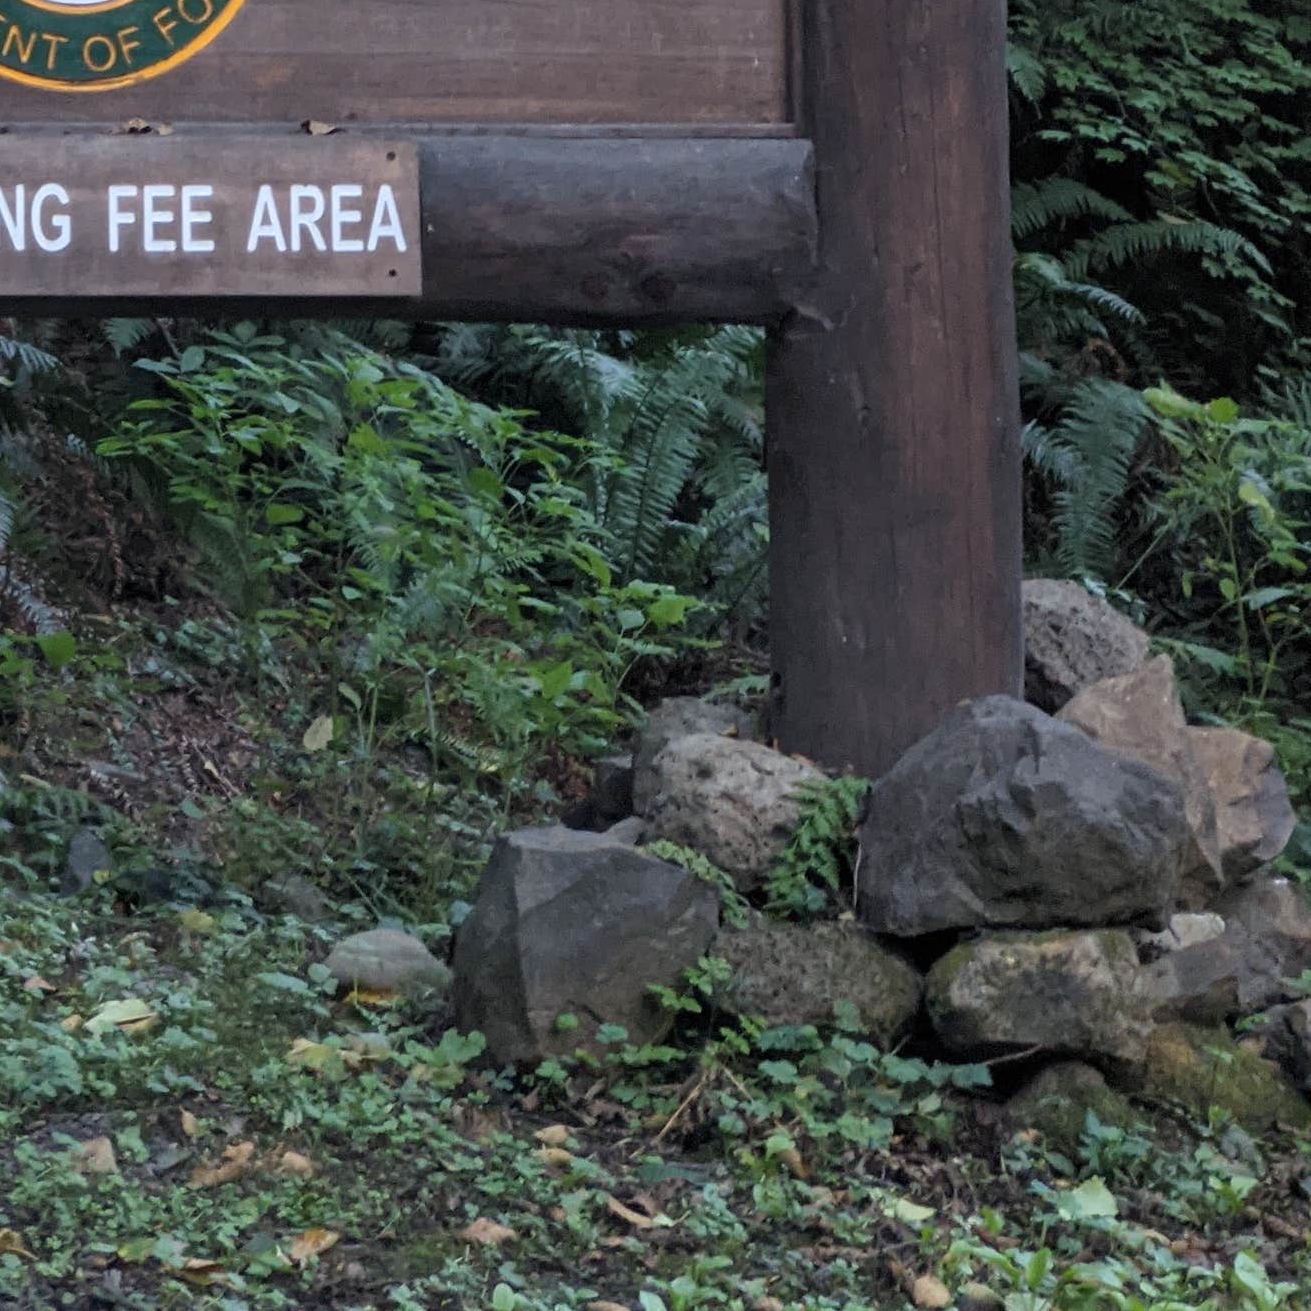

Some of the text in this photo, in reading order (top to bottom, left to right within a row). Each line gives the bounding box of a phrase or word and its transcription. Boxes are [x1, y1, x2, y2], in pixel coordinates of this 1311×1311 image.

[82, 26, 142, 72] OF
[107, 184, 215, 253] FEE
[246, 184, 407, 254] AREA
